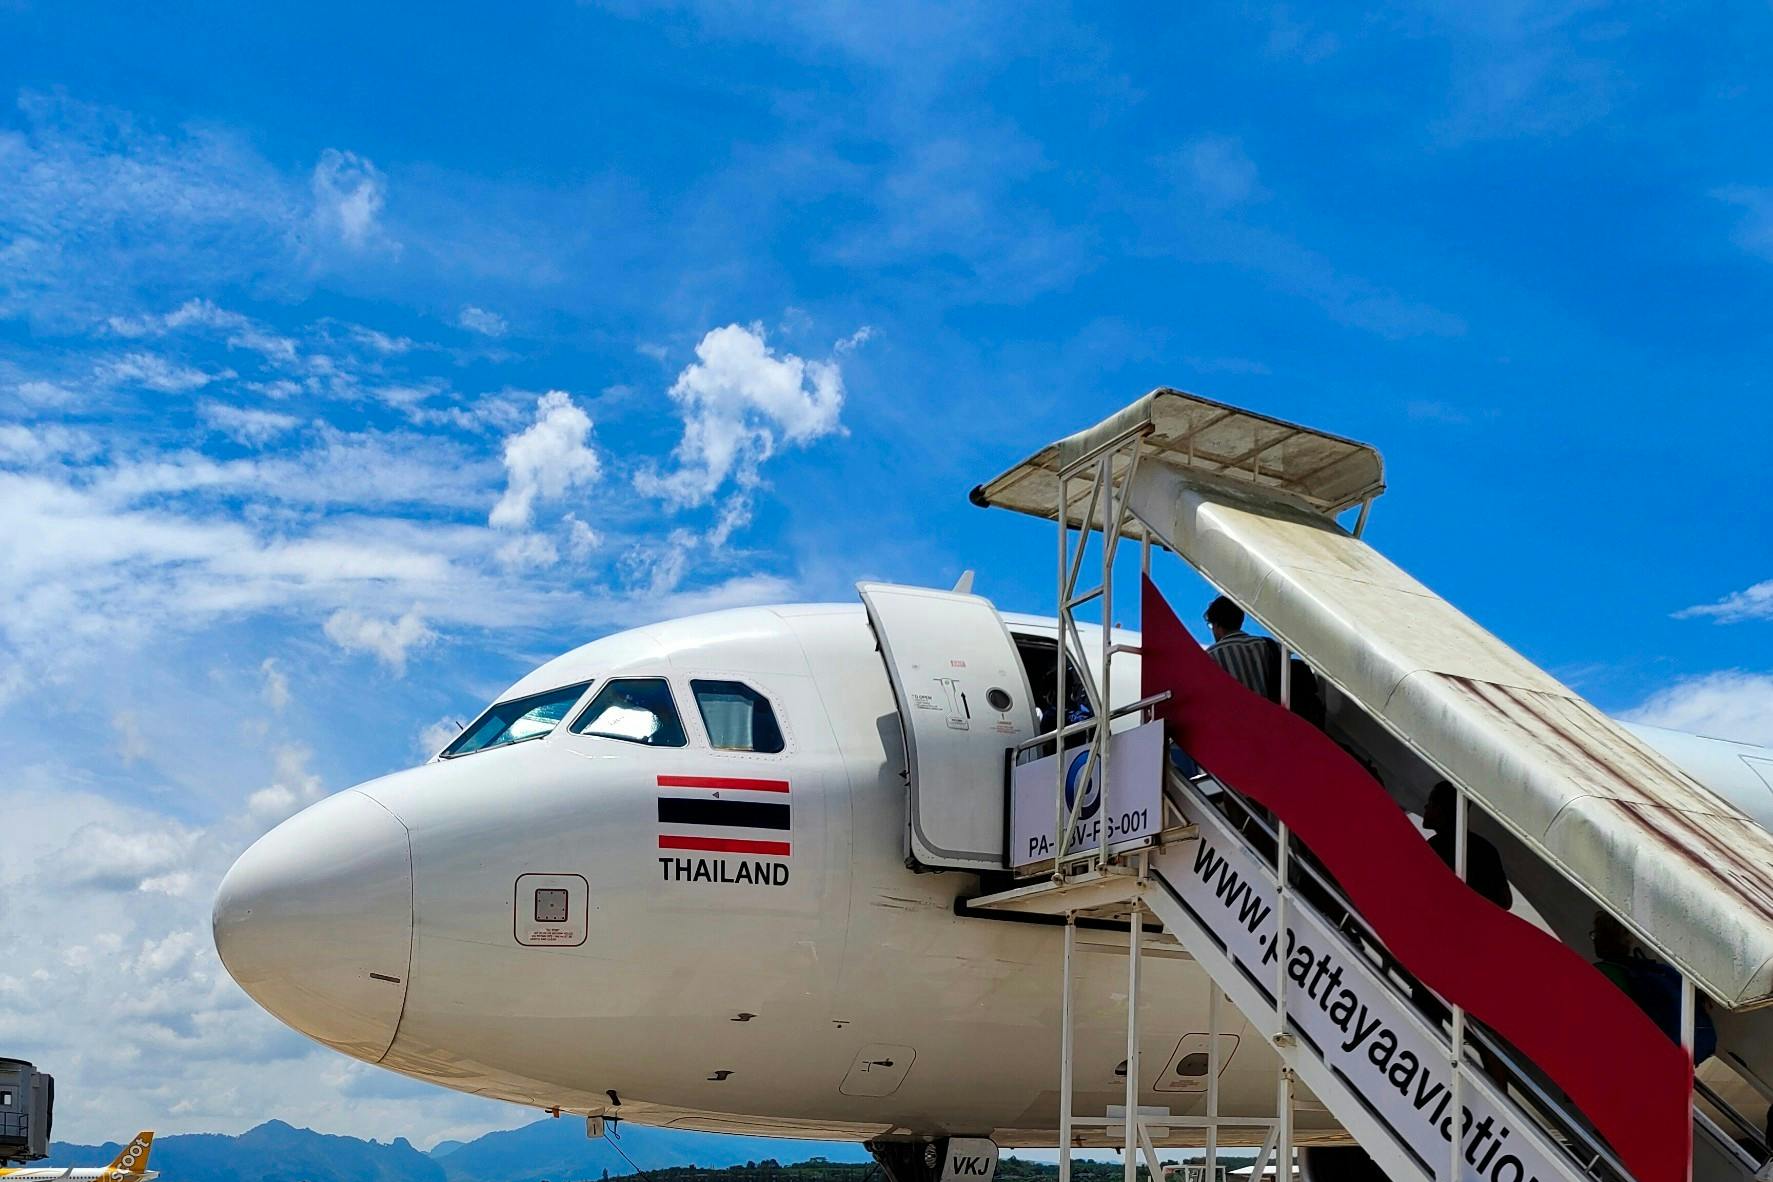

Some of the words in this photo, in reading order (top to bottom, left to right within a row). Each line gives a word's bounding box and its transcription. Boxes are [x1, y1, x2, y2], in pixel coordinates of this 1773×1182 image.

[658, 857, 789, 886] THAILAND
[111, 1137, 150, 1182] scoot
[953, 1156, 990, 1176] VKJ
